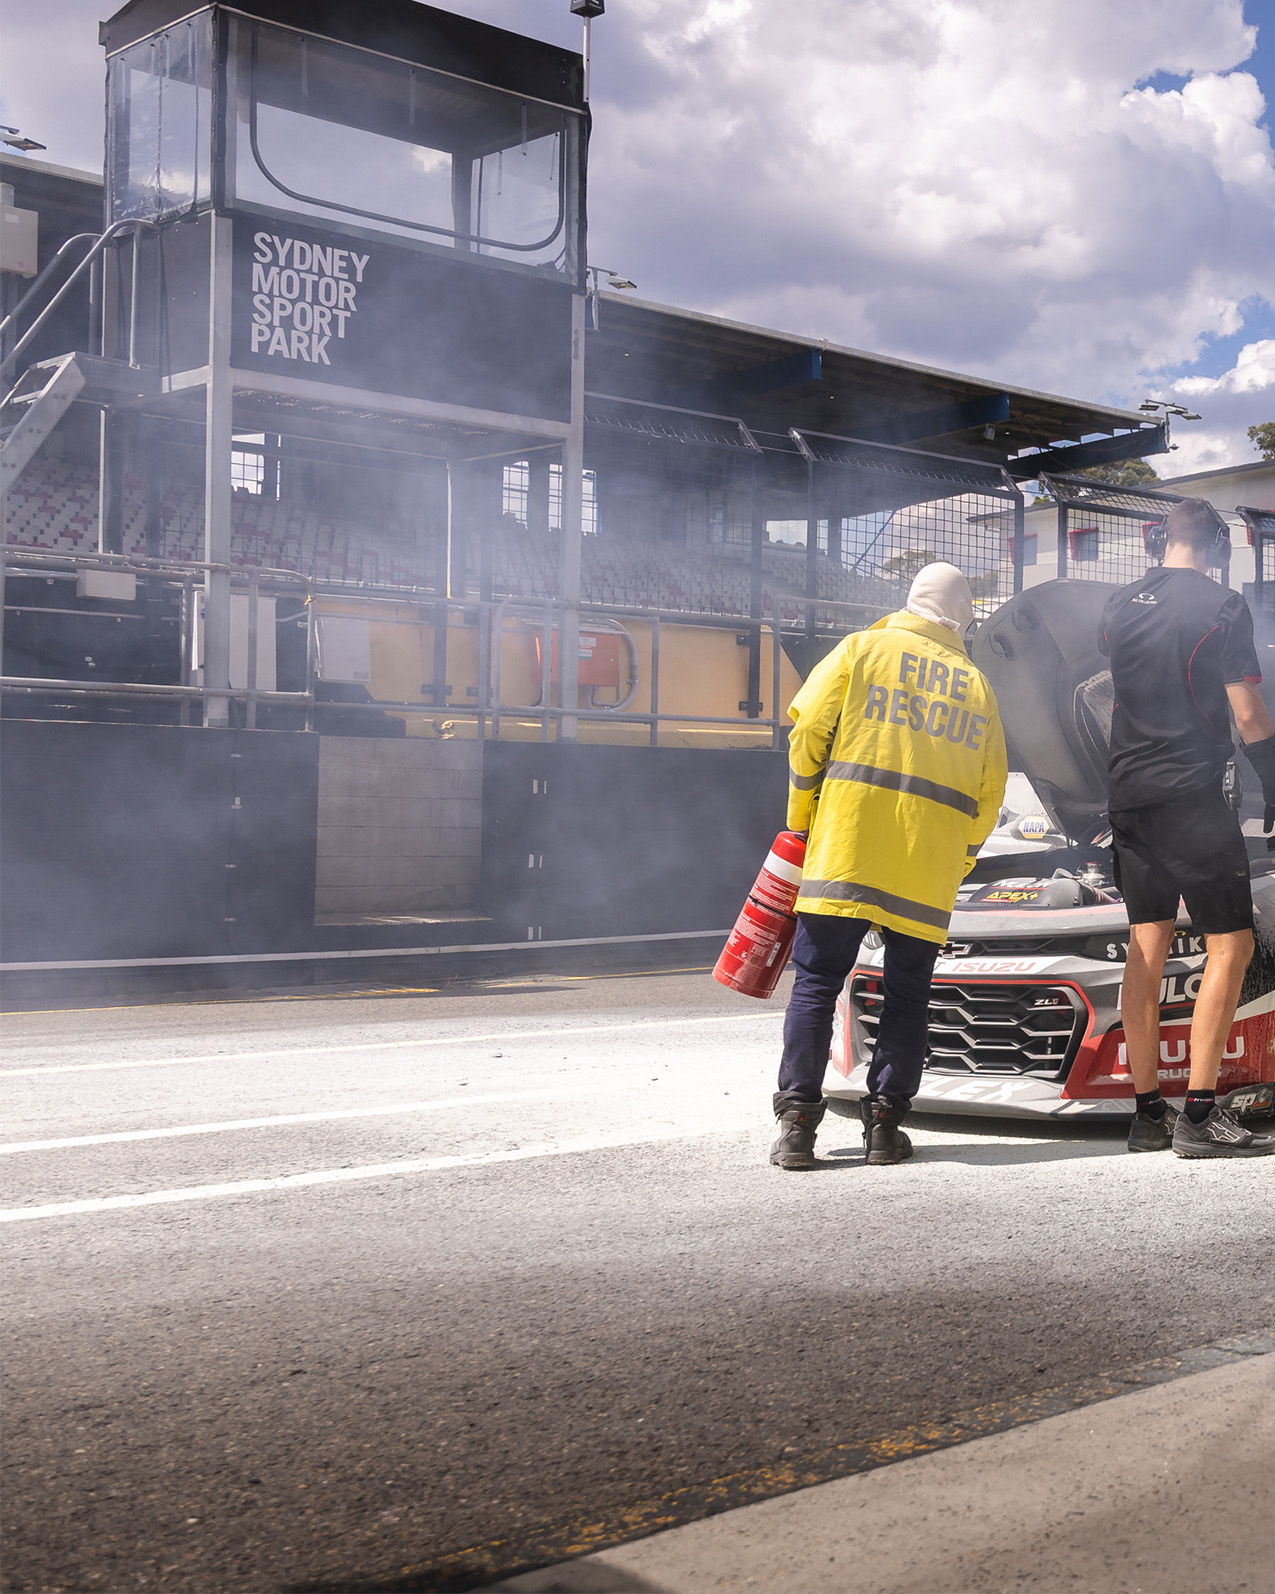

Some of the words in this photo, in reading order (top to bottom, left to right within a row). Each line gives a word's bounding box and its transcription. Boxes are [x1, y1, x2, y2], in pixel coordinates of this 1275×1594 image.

[253, 231, 371, 283] SYDNEY
[252, 262, 358, 312] MOTOR
[252, 293, 351, 339] SPORT
[251, 322, 332, 366] PARK
[899, 651, 969, 703] FIRE
[864, 684, 988, 751] RESCUE
[1022, 821, 1045, 833] NAPA
[951, 961, 1037, 973] ISUZU
[1034, 998, 1059, 1006] ZL1
[1230, 1093, 1257, 1114] SP
